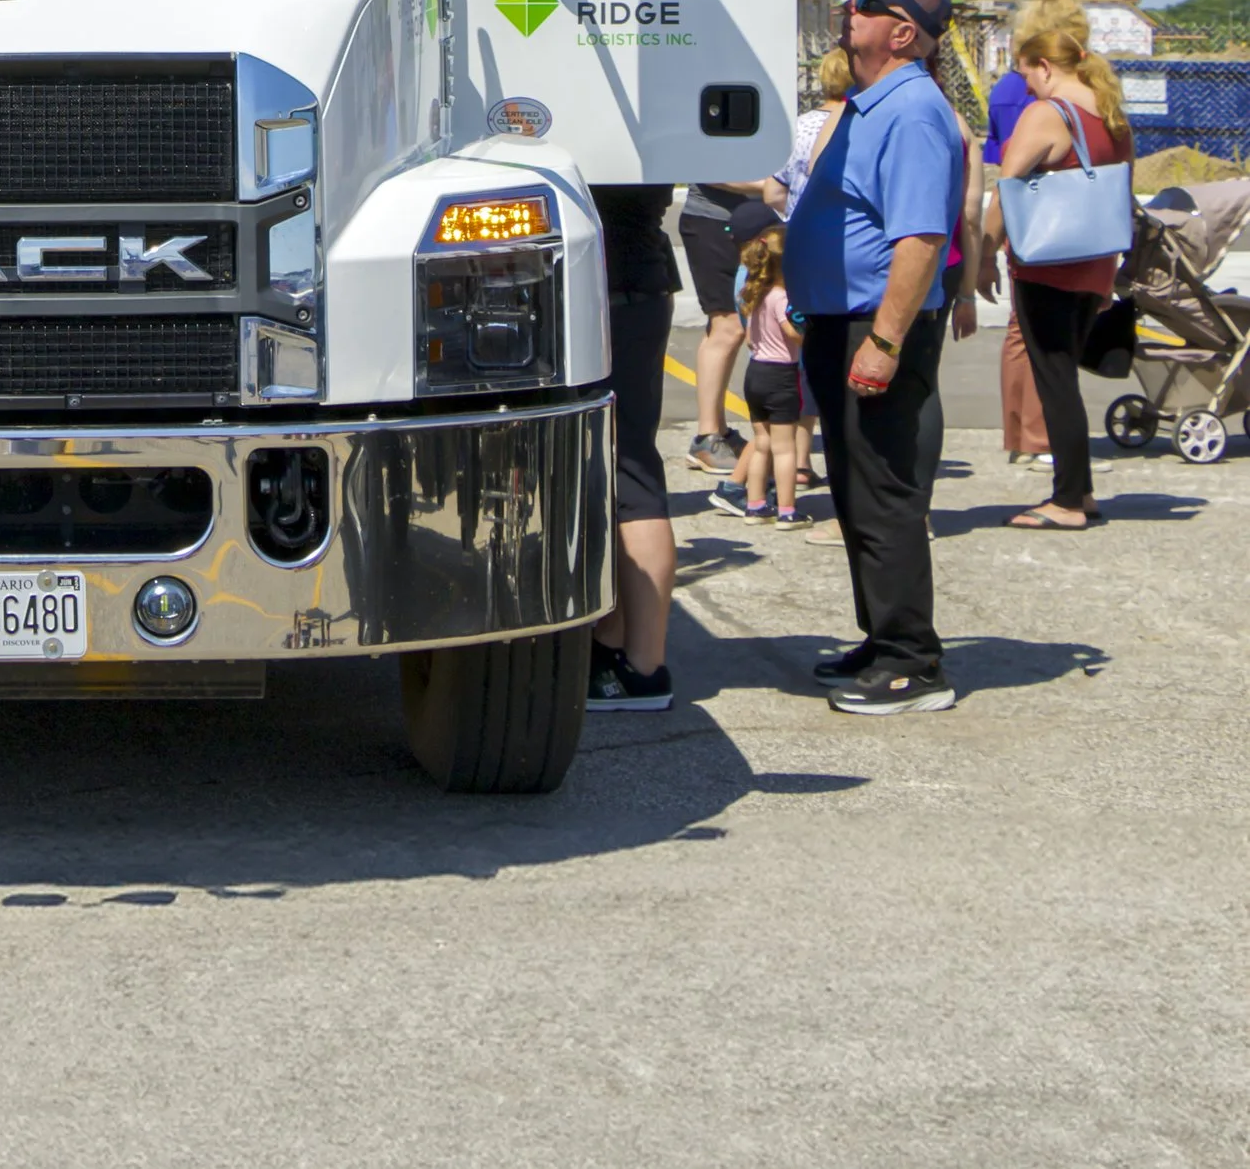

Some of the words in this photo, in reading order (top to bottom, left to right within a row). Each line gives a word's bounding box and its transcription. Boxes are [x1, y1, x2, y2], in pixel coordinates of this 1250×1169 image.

[577, 2, 680, 25] RIDGE
[577, 33, 660, 46] LOGISTICS
[665, 33, 697, 45] INC.
[2, 638, 41, 647] DISCOVER
